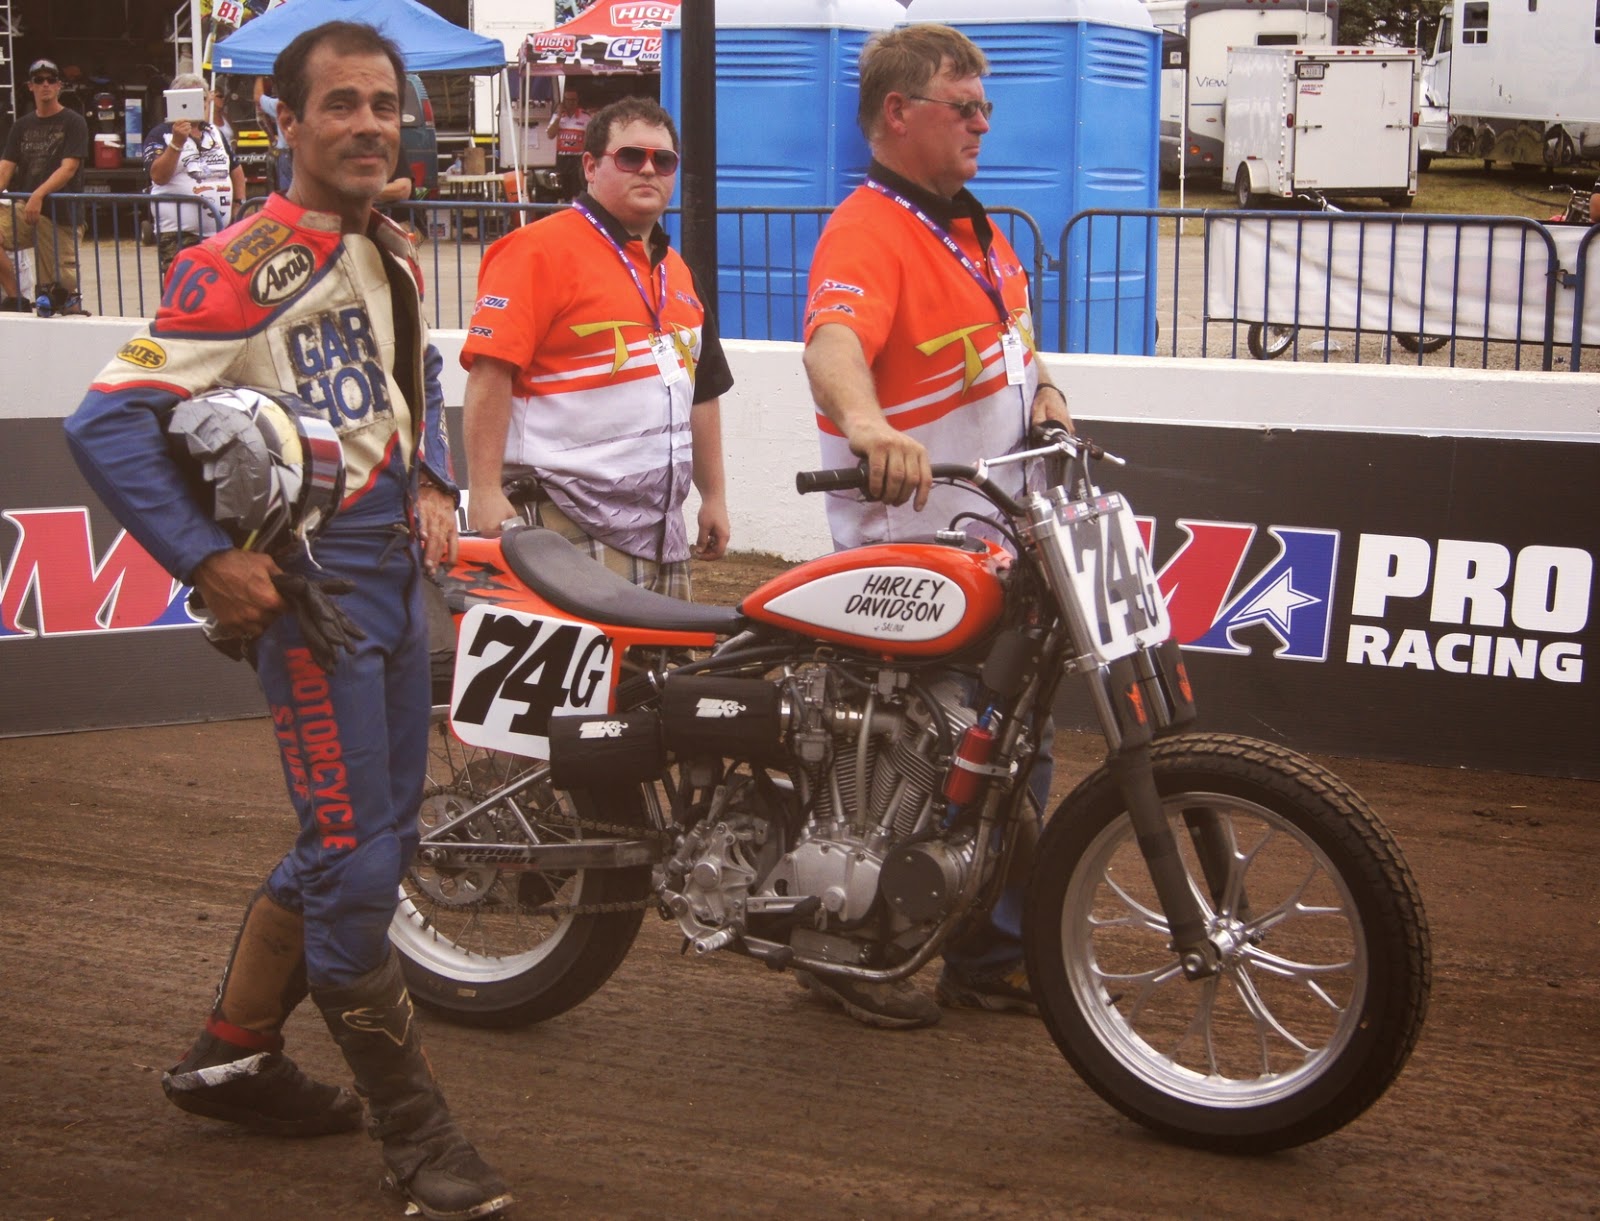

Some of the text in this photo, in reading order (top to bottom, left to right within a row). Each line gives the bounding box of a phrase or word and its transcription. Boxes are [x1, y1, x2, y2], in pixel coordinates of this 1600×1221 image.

[1196, 76, 1228, 88] View
[162, 261, 220, 313] 16
[260, 246, 311, 302] Arai
[289, 308, 378, 376] GAR
[845, 594, 945, 622] DAVIDSON
[862, 574, 945, 601] HARLEY
[1351, 533, 1593, 633] PRO
[1346, 624, 1583, 683] RACING
[579, 721, 628, 739] K&N
[695, 698, 746, 718] K&N
[287, 648, 357, 849] MOTORCYCLE
